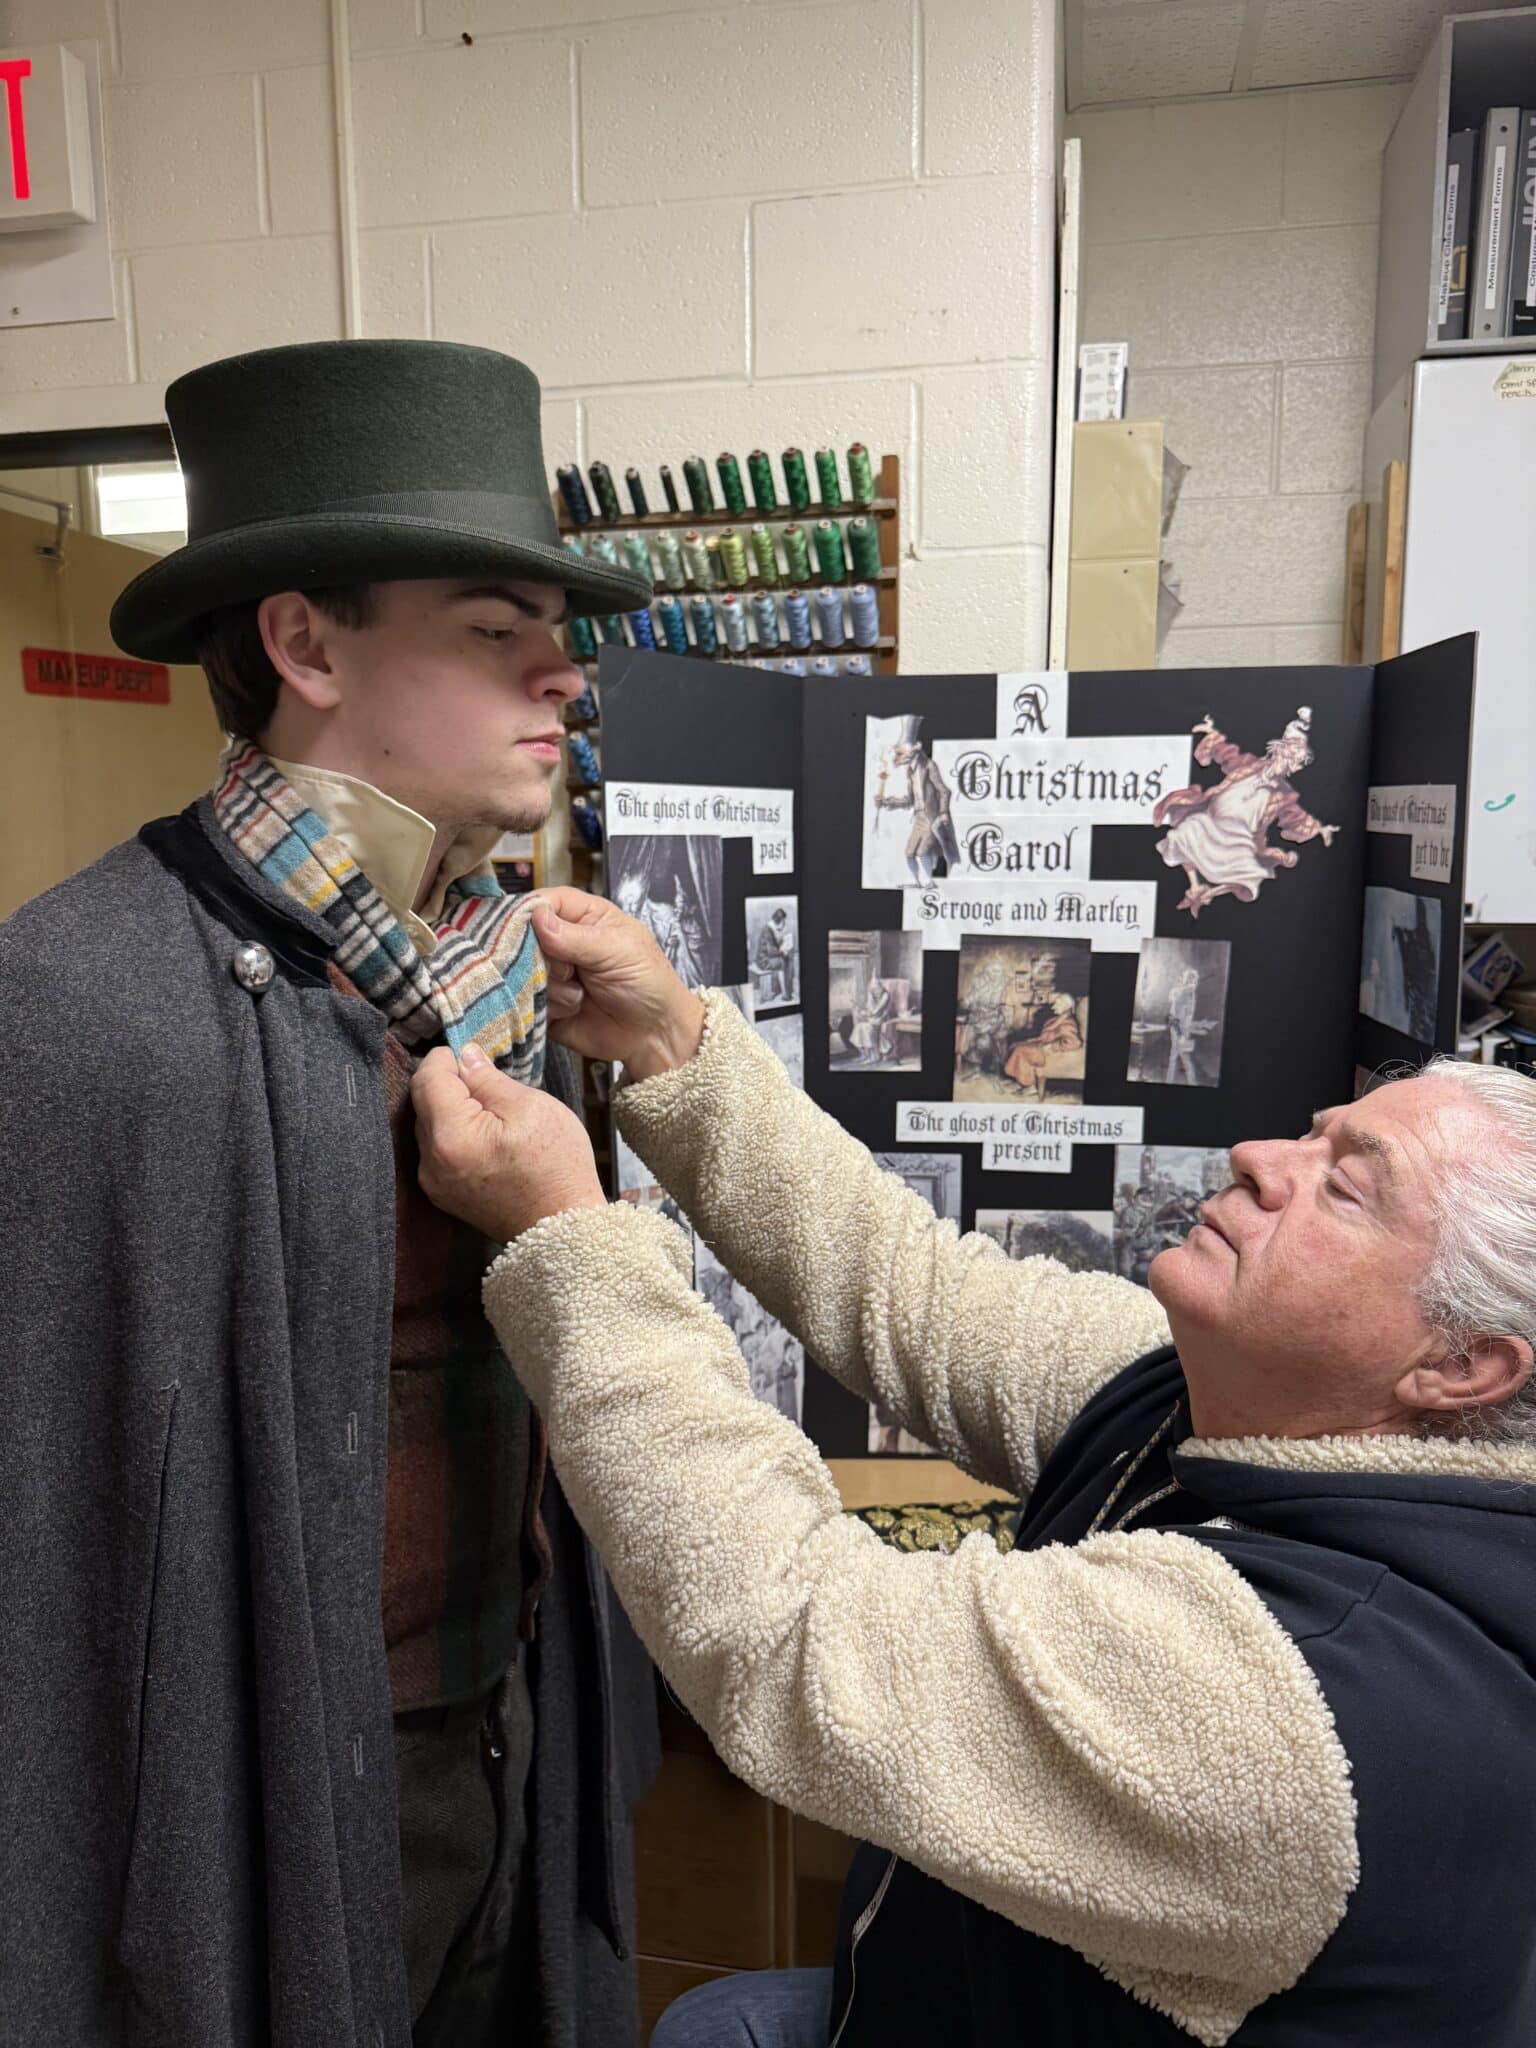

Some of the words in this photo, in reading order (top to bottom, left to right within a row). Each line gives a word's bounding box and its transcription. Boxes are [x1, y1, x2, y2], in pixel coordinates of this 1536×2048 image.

[1447, 184, 1457, 220] Forms
[1444, 223, 1453, 257] Class
[1488, 207, 1500, 290] Measurement
[1494, 167, 1503, 204] Forms
[1440, 260, 1451, 305] Makeup
[37, 656, 110, 689] MAKEUP
[1012, 683, 1049, 735] A
[951, 750, 1168, 806] Christmas
[615, 788, 649, 818] The
[653, 794, 691, 825] ghost
[694, 798, 709, 821] of
[712, 794, 781, 824] Christmas
[1407, 794, 1448, 824] Christmas
[760, 838, 788, 867] past
[961, 822, 1078, 873] Carol
[1429, 840, 1438, 867] to
[1440, 836, 1450, 869] be
[917, 892, 1003, 927] Scrooge
[1011, 898, 1048, 922] and
[1053, 891, 1140, 930] Marley
[906, 1106, 944, 1132] The
[949, 1109, 996, 1137] ghost
[1001, 1112, 1018, 1135] of
[1023, 1110, 1123, 1139] Christmas
[992, 1140, 1062, 1164] present
